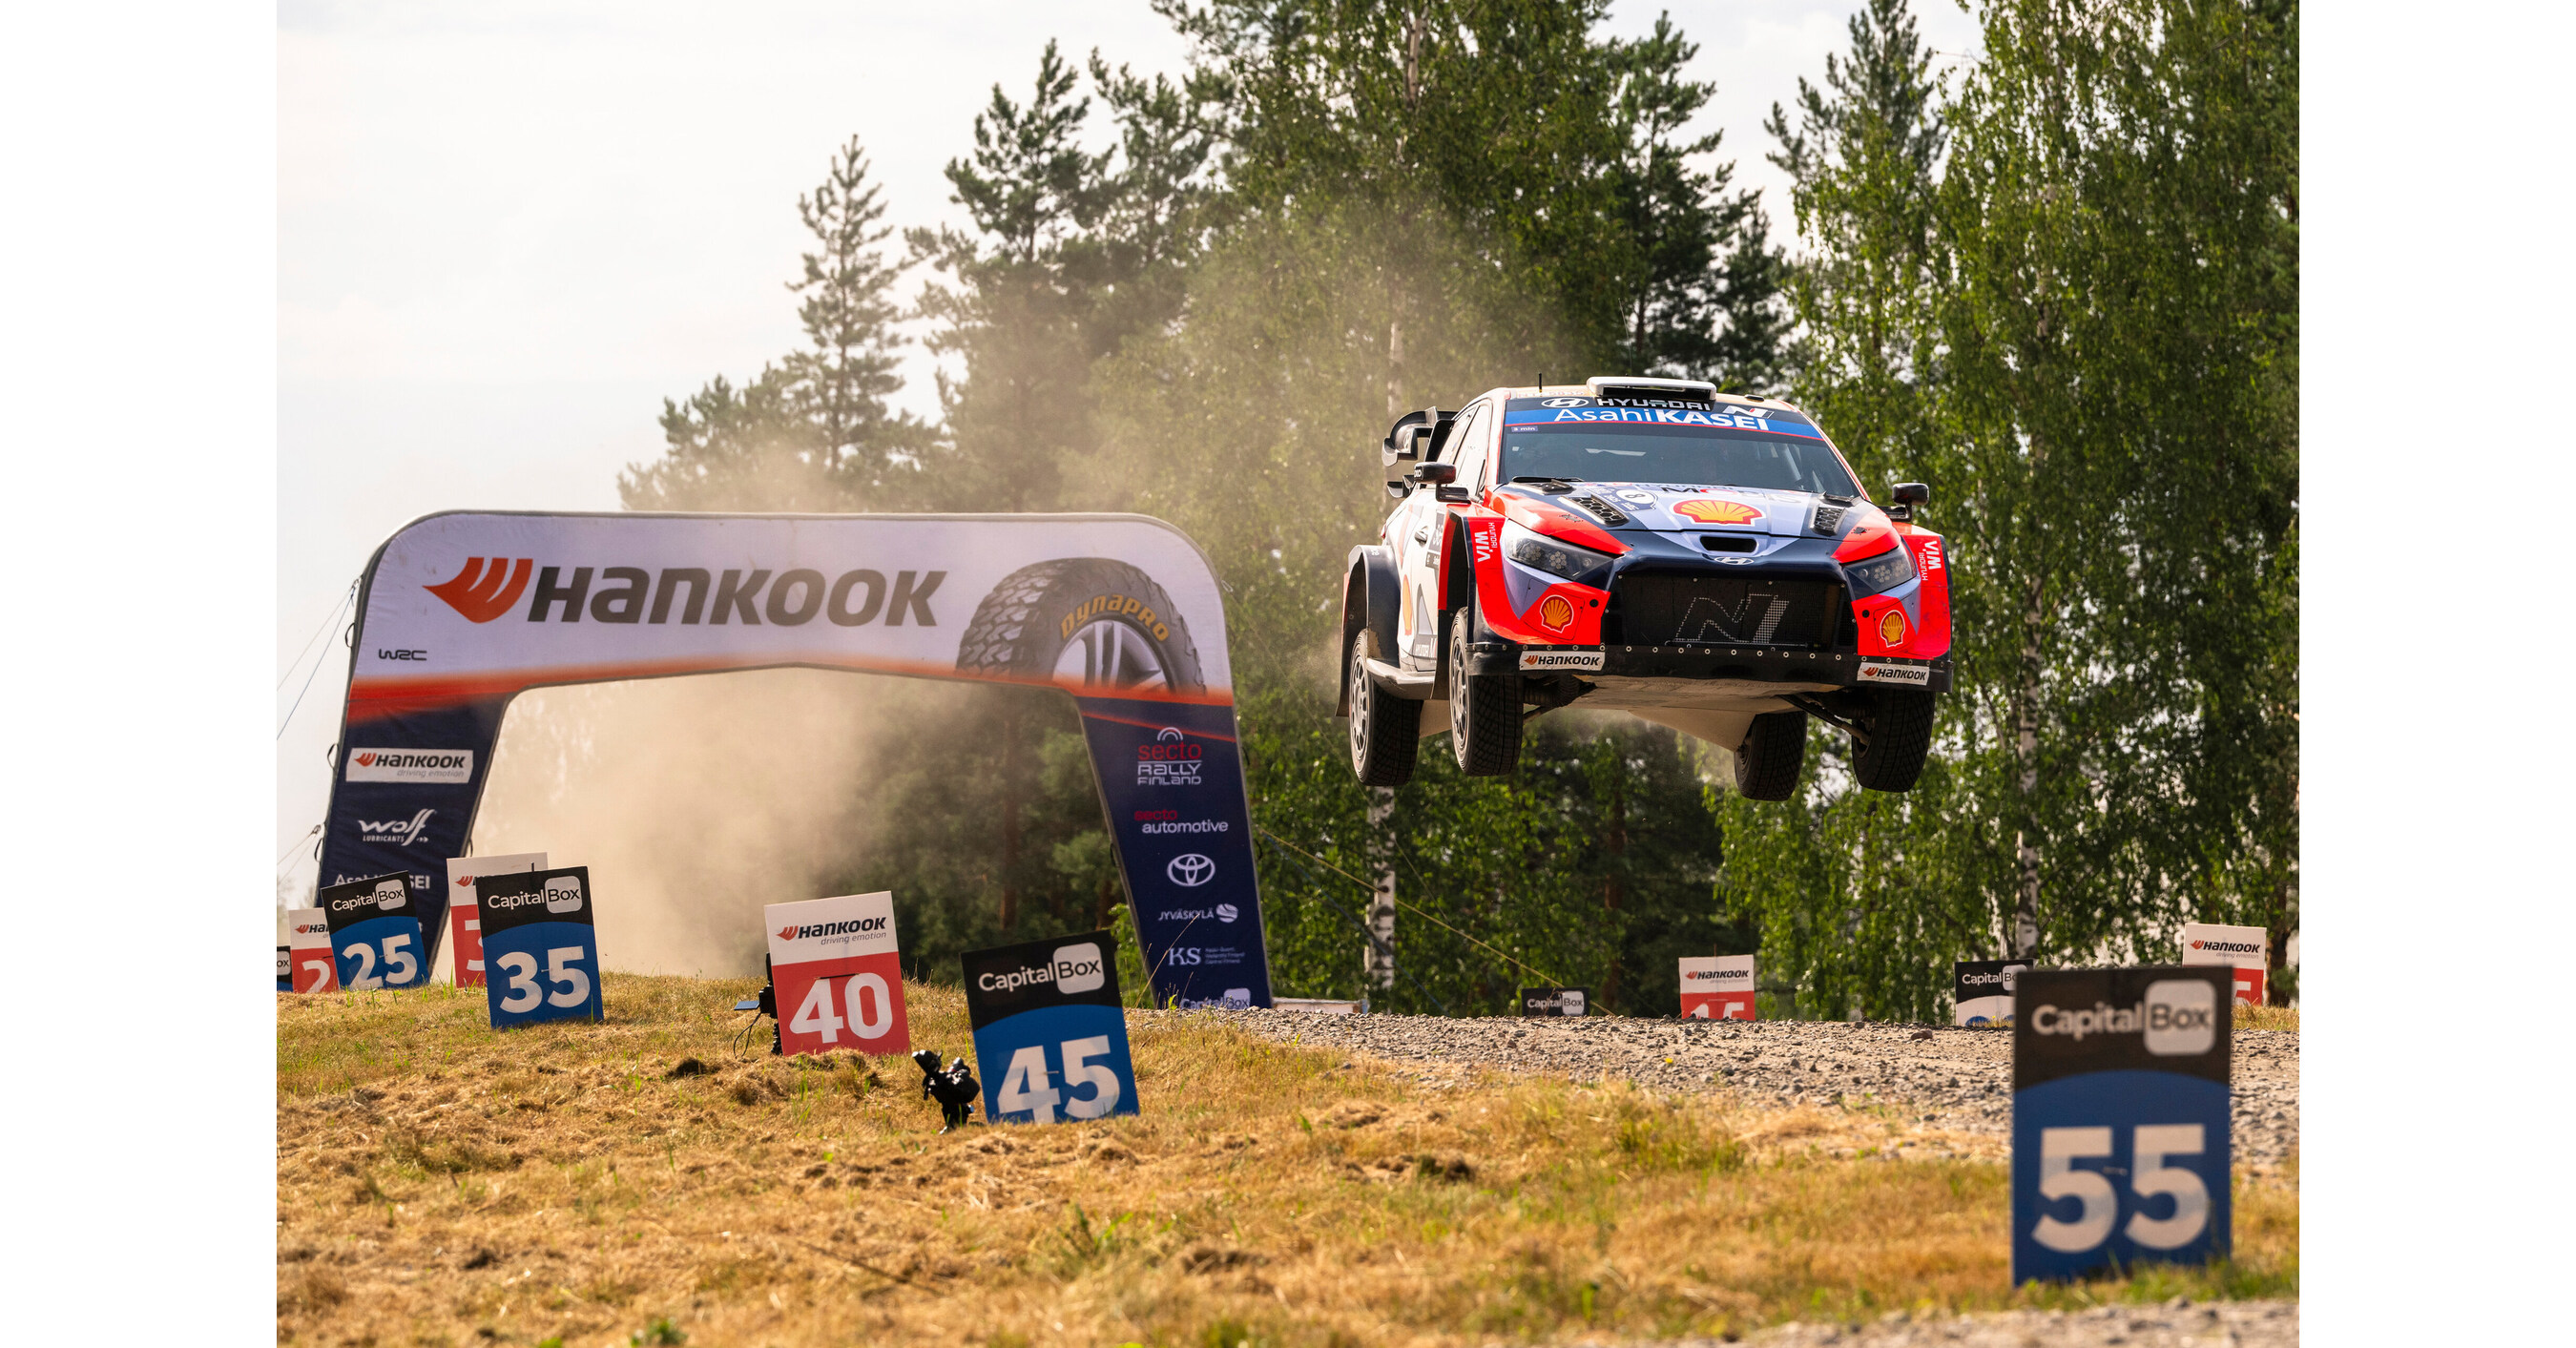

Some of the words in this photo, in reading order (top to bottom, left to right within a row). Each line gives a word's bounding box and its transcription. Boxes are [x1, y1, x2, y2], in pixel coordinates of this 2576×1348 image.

[378, 648, 427, 661] WRC
[1137, 741, 1202, 760] secto
[397, 769, 426, 778] driving
[1134, 809, 1177, 820] secto
[1142, 819, 1229, 834] automotive
[1157, 907, 1215, 922] JYVÄSKYLÄ
[821, 936, 850, 945] driving
[852, 932, 886, 942] emotion
[342, 933, 418, 991] 25
[1168, 947, 1202, 965] KS
[301, 959, 331, 993] 2
[496, 945, 591, 1014] 35
[789, 972, 893, 1044] 40
[997, 1034, 1120, 1124] 45
[2031, 1123, 2210, 1253] 55
